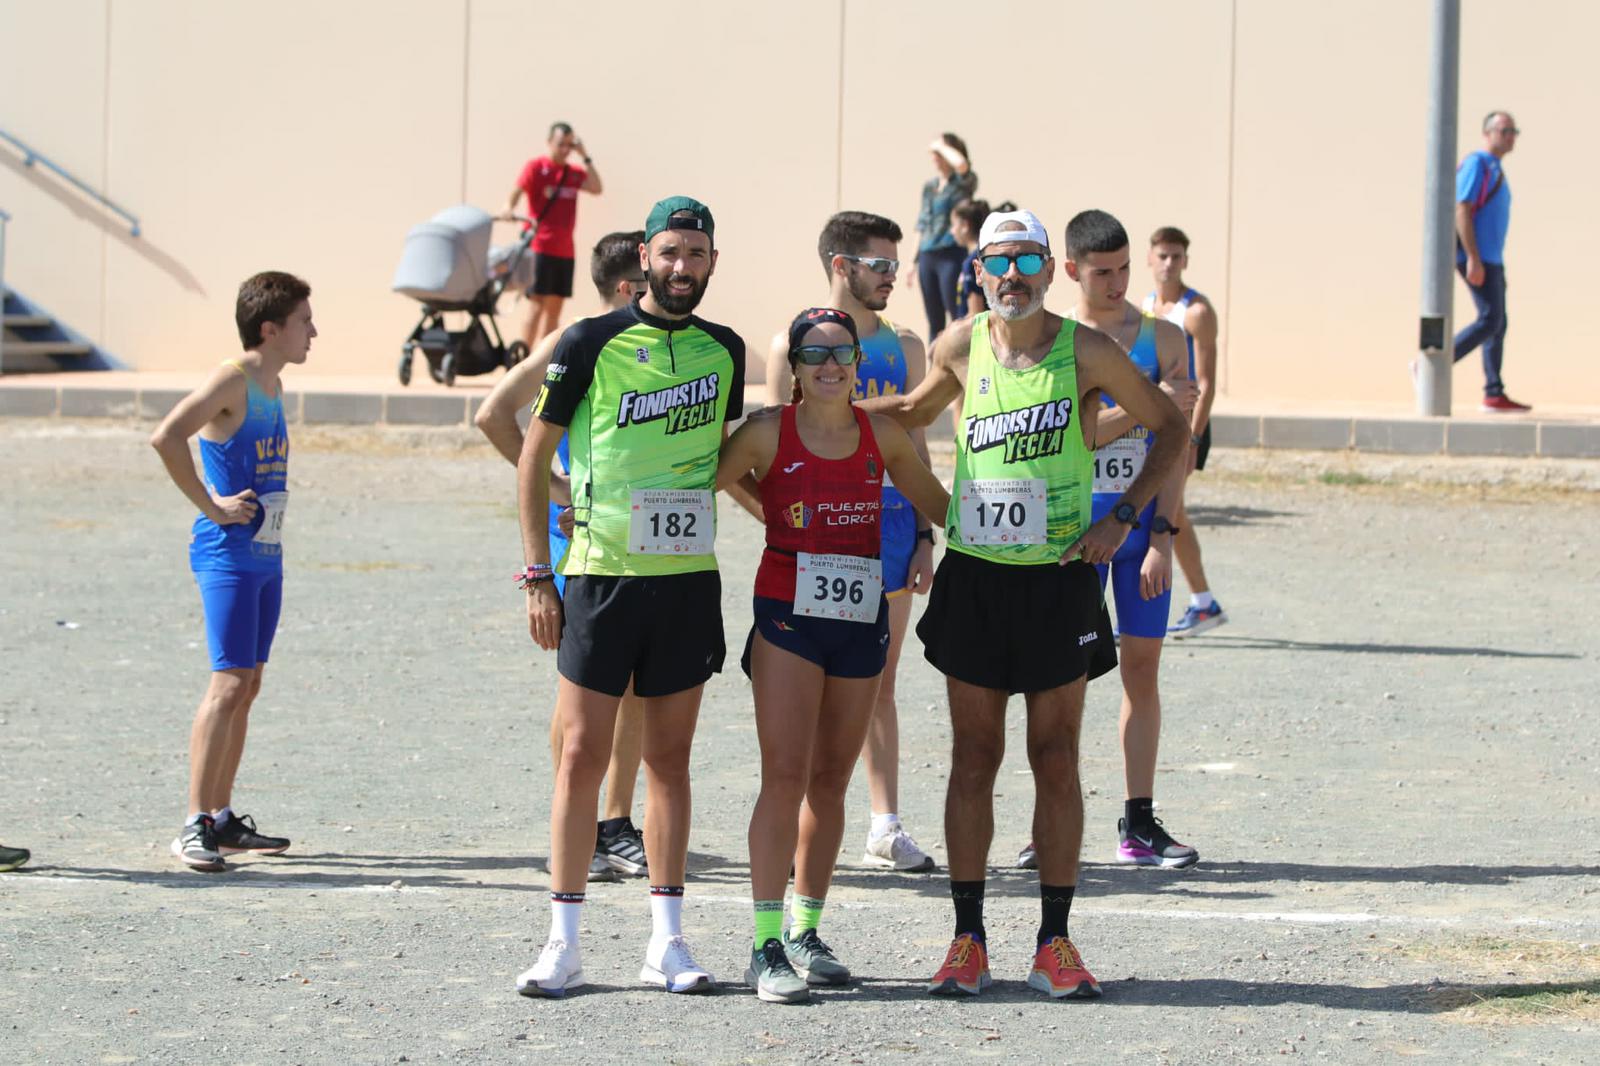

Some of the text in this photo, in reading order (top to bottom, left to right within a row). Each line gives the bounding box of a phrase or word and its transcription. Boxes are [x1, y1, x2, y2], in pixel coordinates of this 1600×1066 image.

[617, 373, 718, 427] FONDISTAS
[665, 400, 716, 434] YECLA
[966, 398, 1072, 452] FONDISTAS
[1004, 430, 1063, 463] YECLA
[1094, 458, 1133, 479] 165
[650, 512, 697, 538] 182
[827, 514, 875, 525] LORCA
[976, 502, 1026, 527] 170
[810, 560, 871, 573] PUERTO LUMBRERAS
[814, 575, 864, 605] 396
